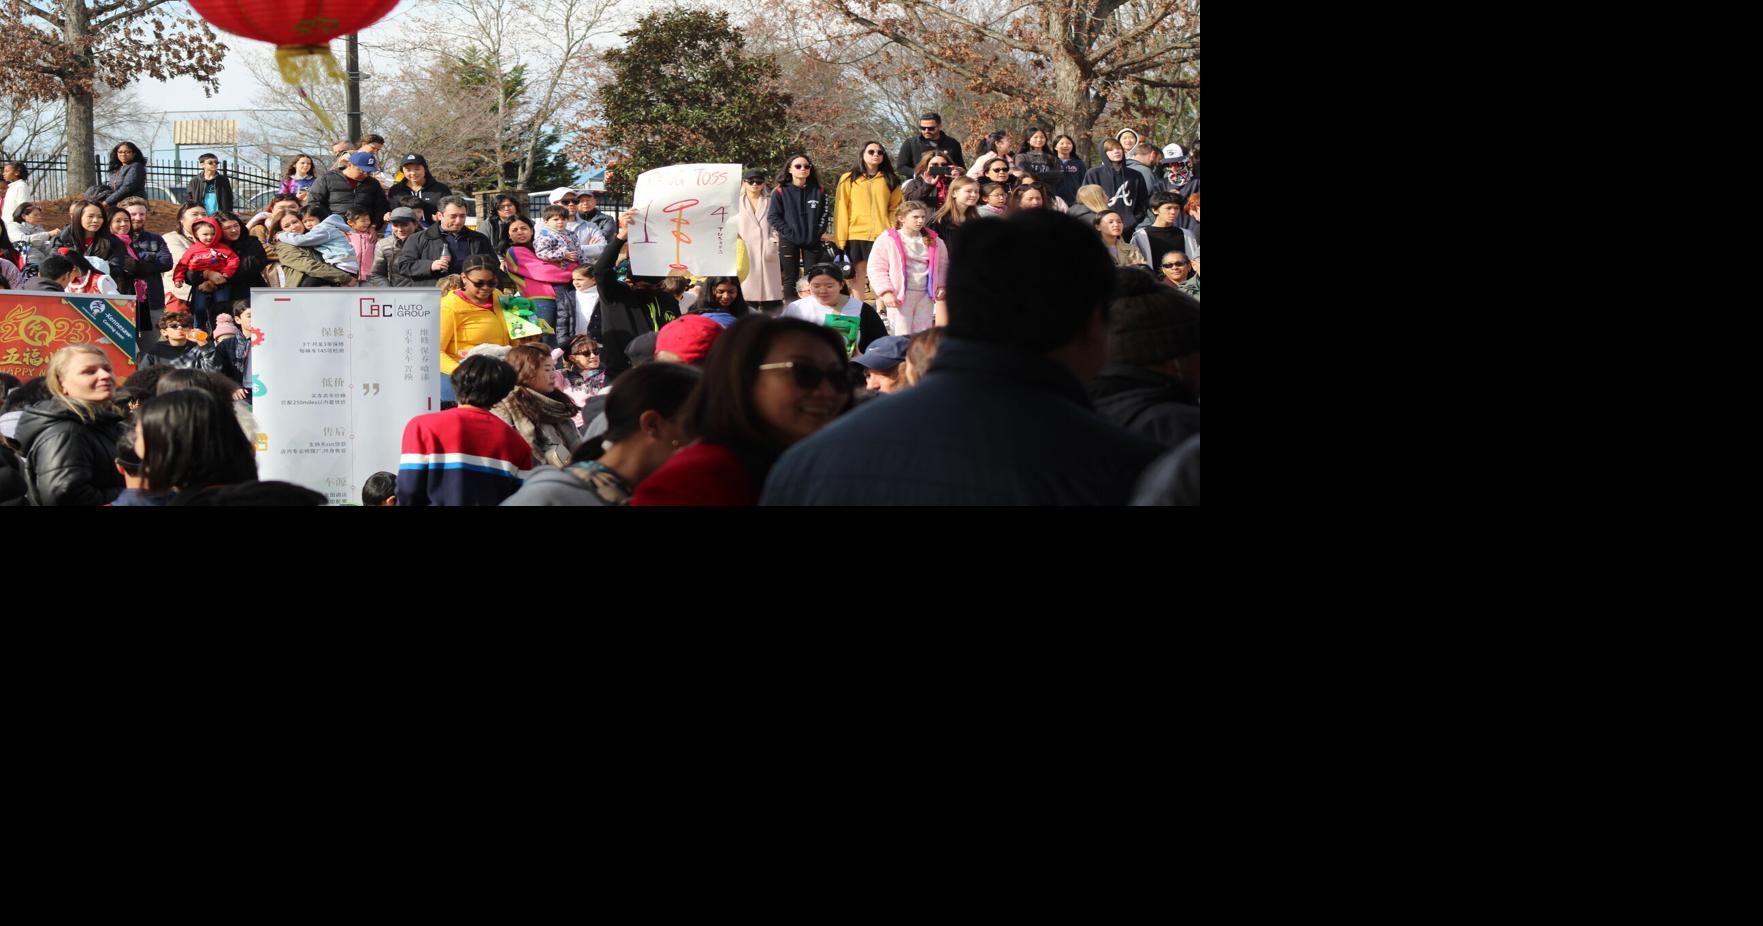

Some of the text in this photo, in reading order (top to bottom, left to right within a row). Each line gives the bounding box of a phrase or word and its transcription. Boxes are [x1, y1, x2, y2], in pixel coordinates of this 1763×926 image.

[1107, 180, 1133, 208] A
[709, 206, 729, 224] 4
[396, 310, 431, 318] GROUP
[0, 347, 50, 367] 五福
